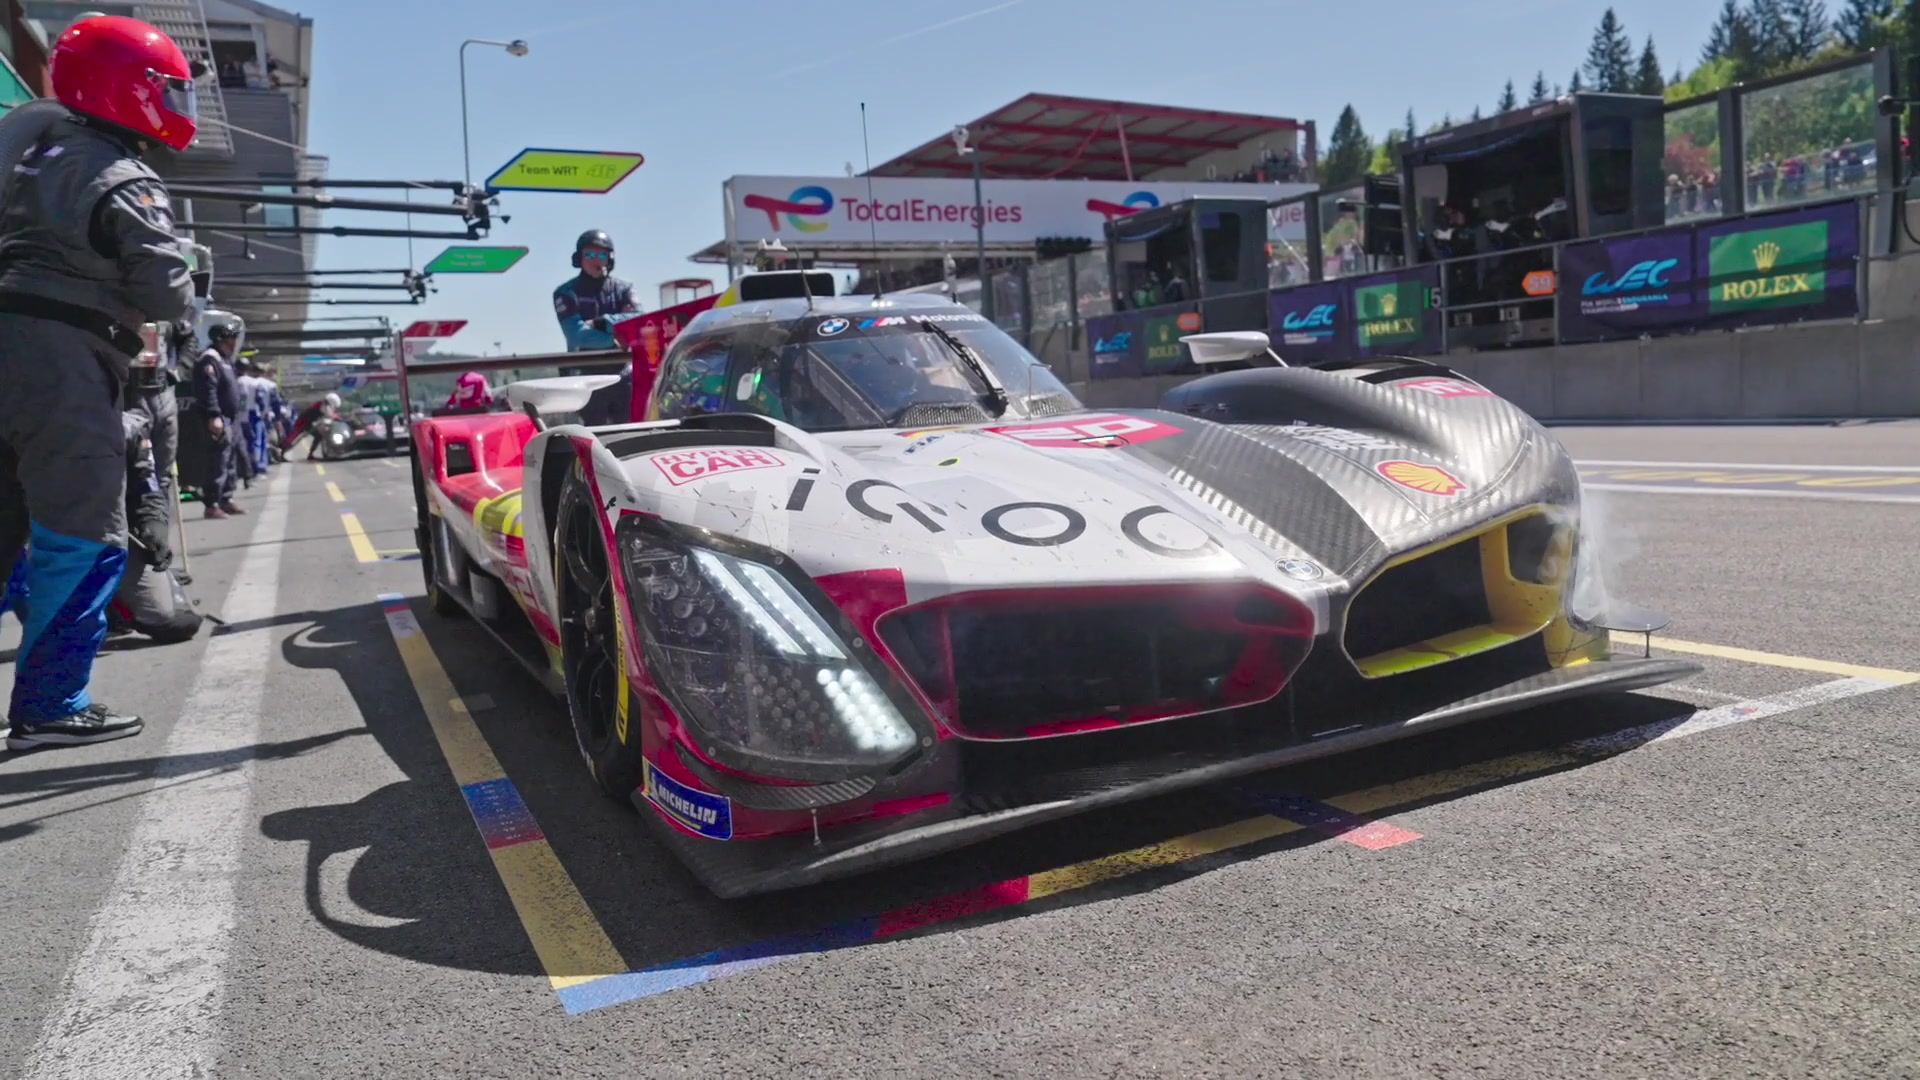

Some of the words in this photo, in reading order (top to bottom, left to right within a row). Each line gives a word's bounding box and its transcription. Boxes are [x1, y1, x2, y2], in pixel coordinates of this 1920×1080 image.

[518, 163, 550, 175] Team
[552, 165, 579, 176] WRT
[840, 198, 1023, 229] TotalEnergies
[1581, 258, 1678, 295] WEC
[1722, 273, 1811, 301] ROLEX
[1365, 317, 1415, 337] ROLEX
[660, 449, 757, 465] HYPER
[670, 454, 773, 478] CAR
[658, 784, 717, 825] MICHELIN
